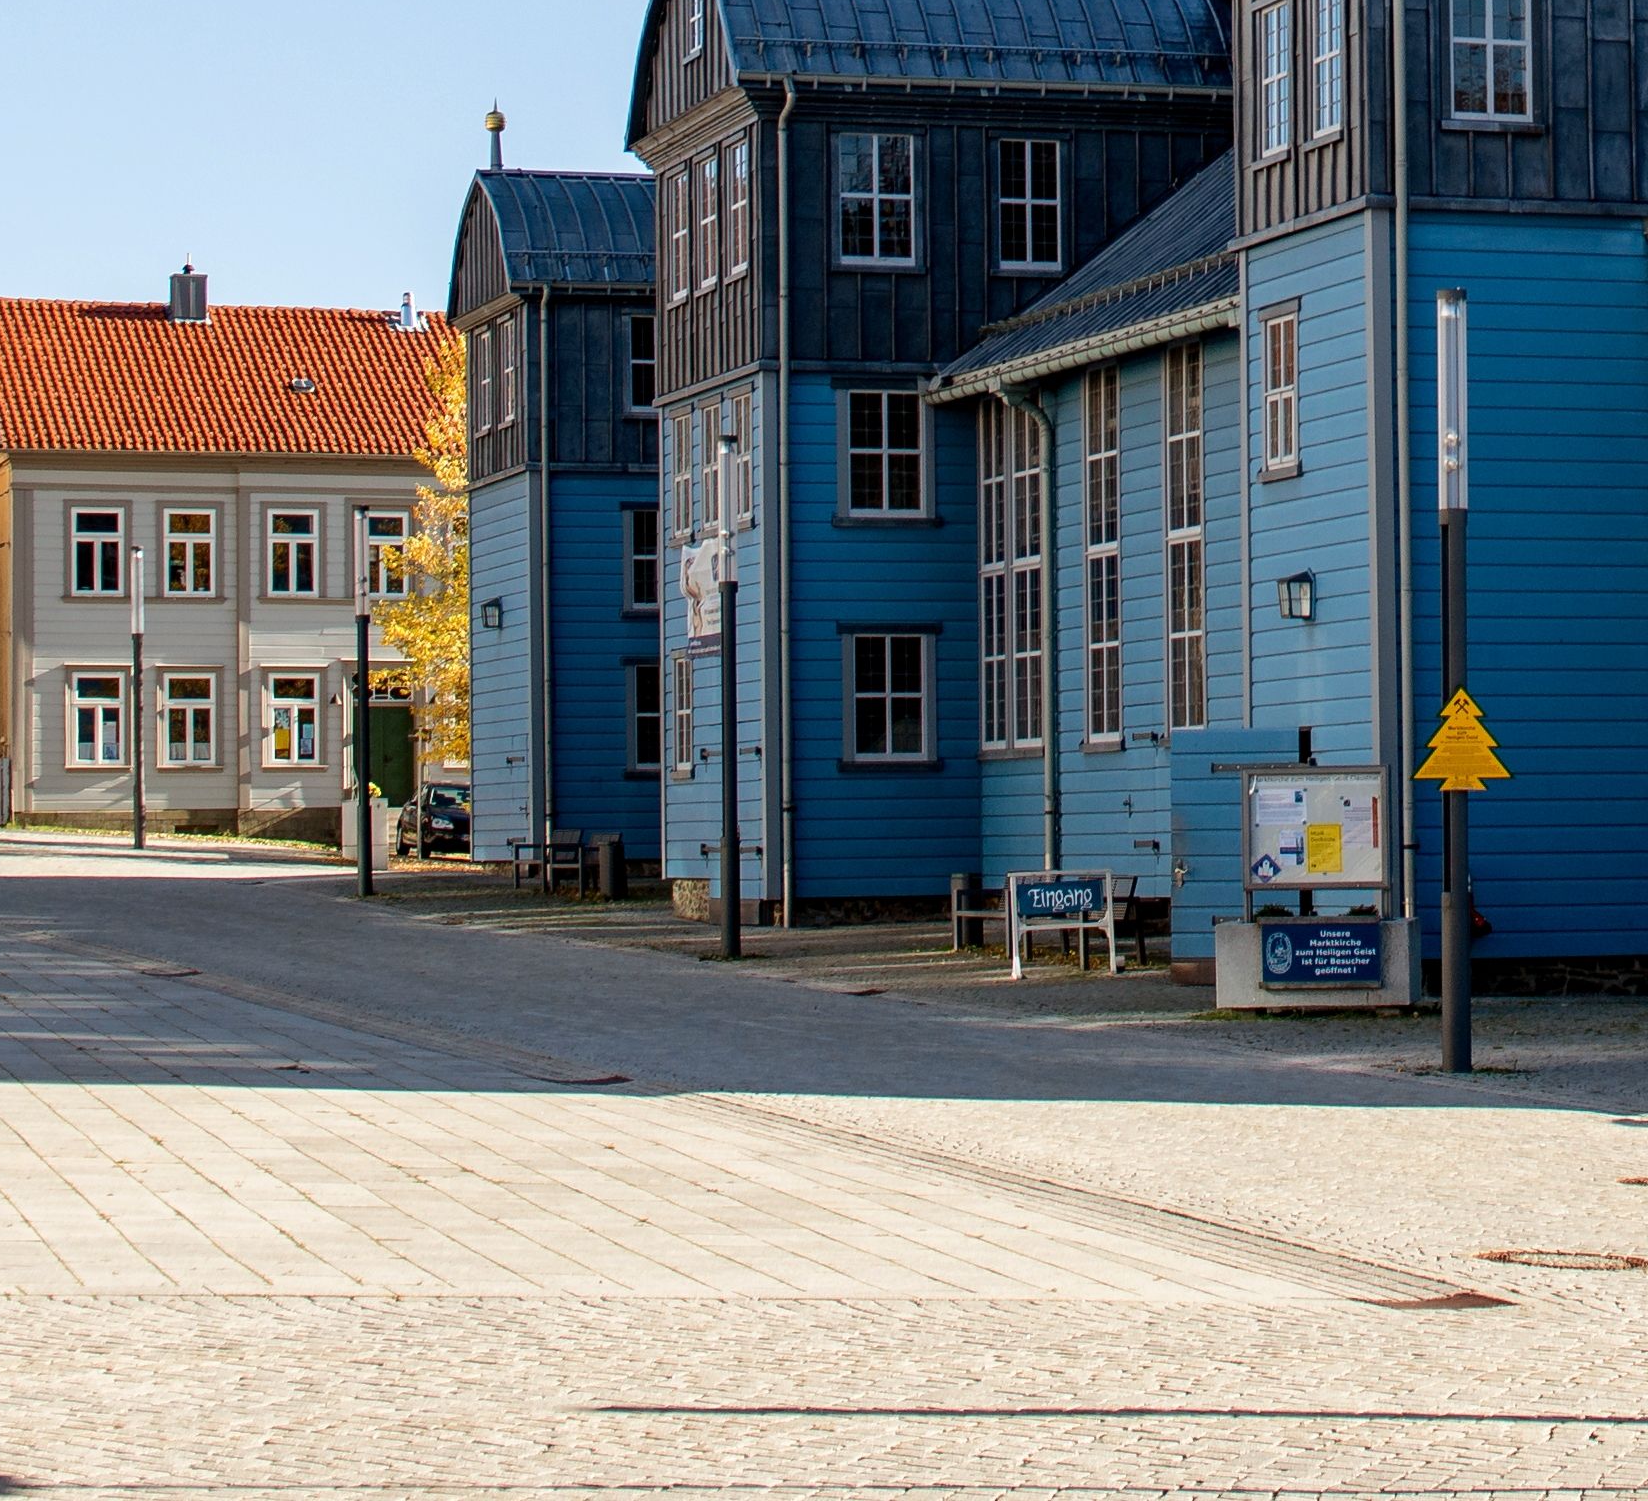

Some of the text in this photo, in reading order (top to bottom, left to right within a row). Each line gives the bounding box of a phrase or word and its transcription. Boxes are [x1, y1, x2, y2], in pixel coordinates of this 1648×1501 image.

[1027, 888, 1092, 912] Eingang
[1314, 957, 1327, 965] für
[1330, 957, 1370, 965] Besucher
[1315, 967, 1351, 976] geöffnet
